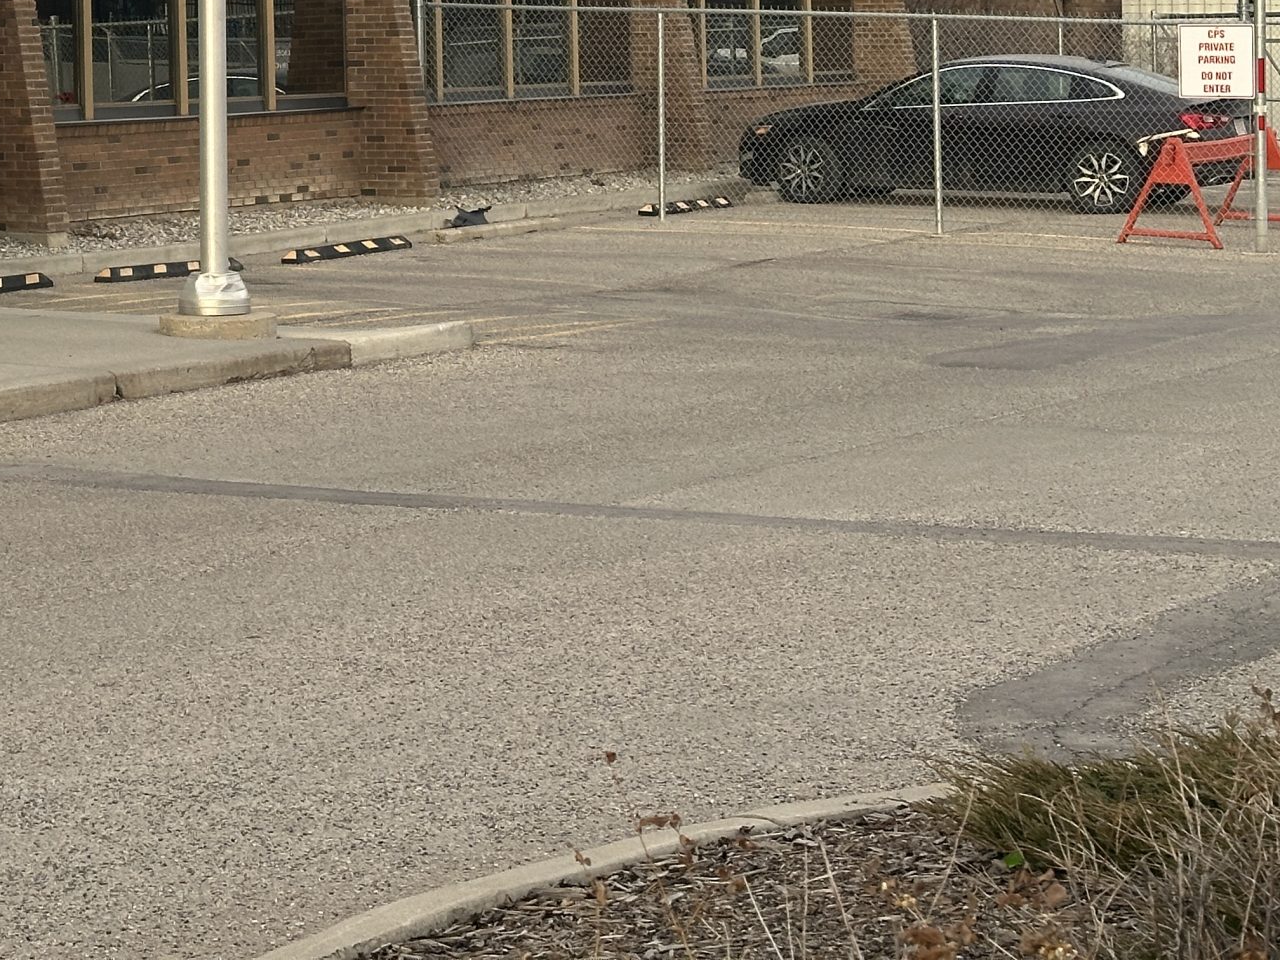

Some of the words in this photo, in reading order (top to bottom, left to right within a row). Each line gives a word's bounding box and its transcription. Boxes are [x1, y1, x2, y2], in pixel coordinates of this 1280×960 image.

[1207, 29, 1225, 39] CPS
[1198, 42, 1235, 52] PRIVATE
[1197, 55, 1236, 65] PARKING
[1201, 71, 1213, 81] DO
[1215, 71, 1233, 81] NOT
[1203, 84, 1231, 93] ENTER
